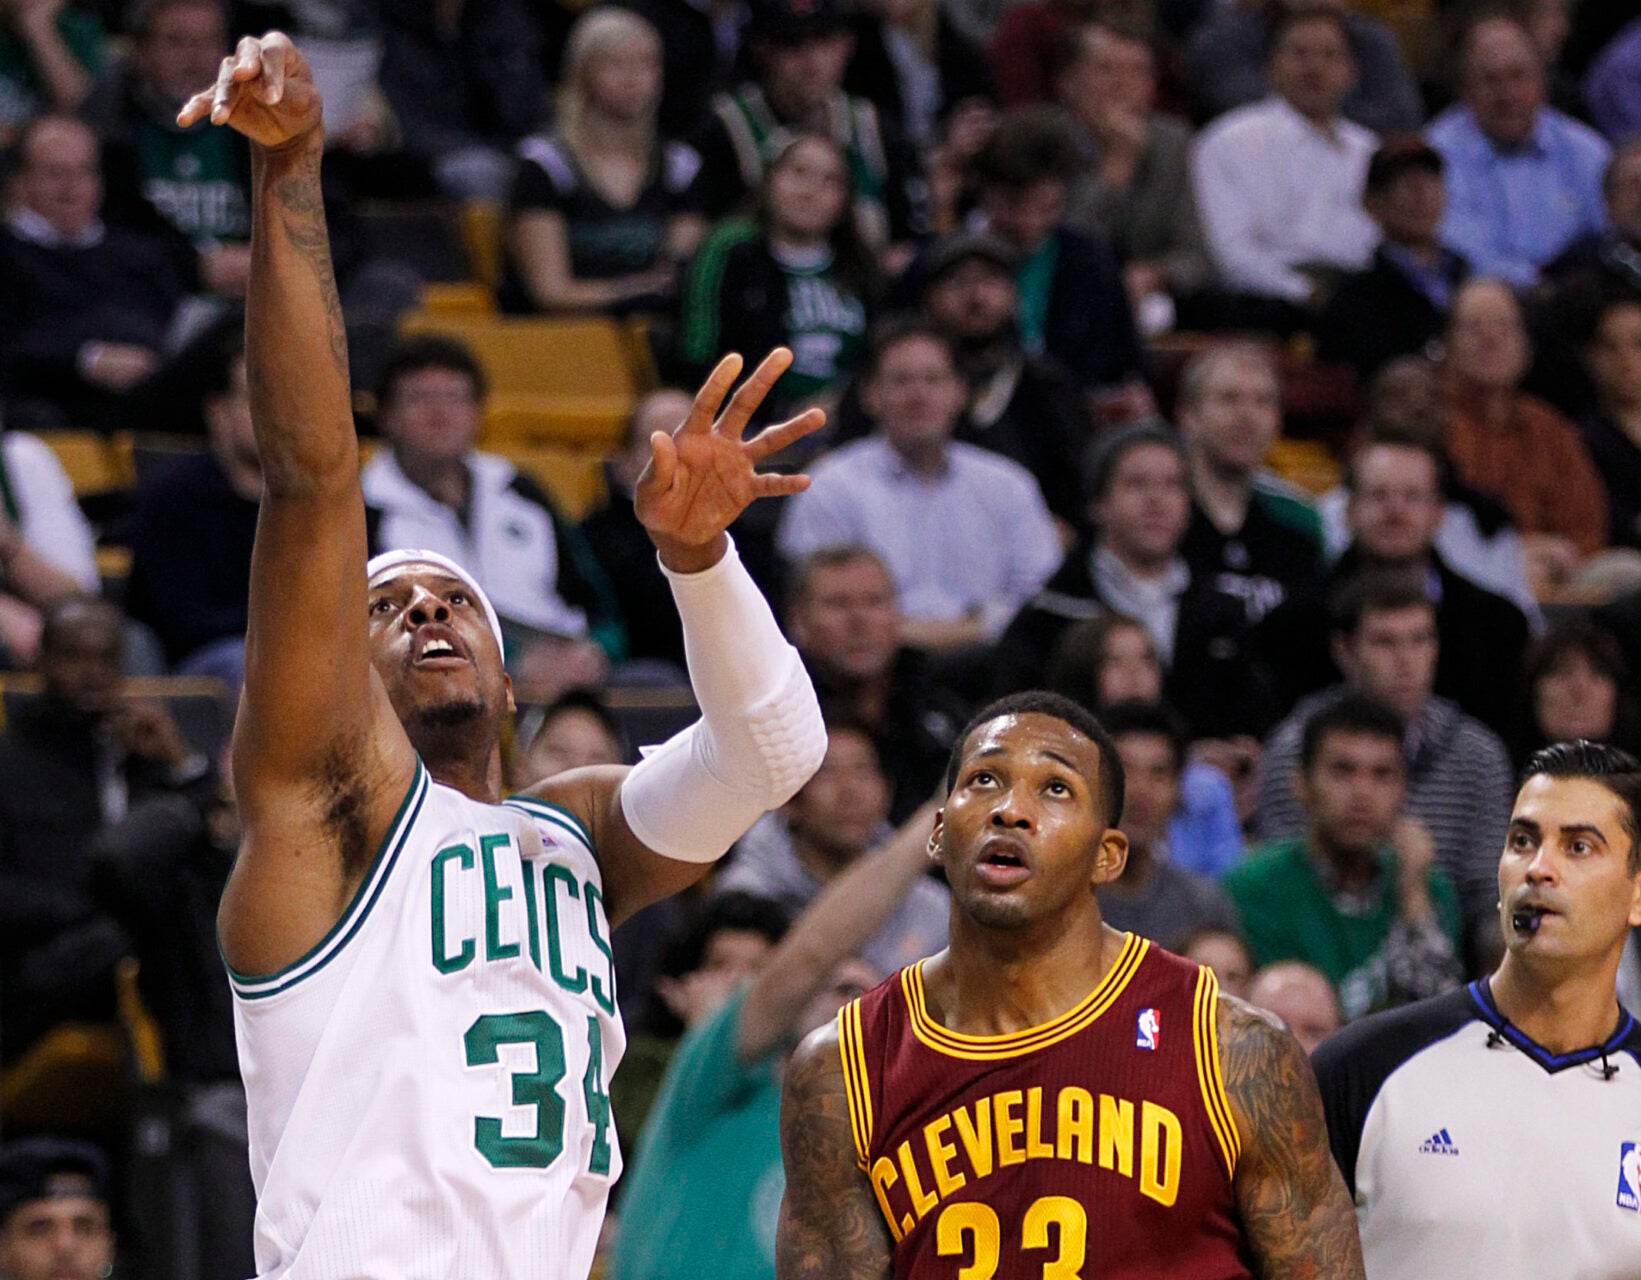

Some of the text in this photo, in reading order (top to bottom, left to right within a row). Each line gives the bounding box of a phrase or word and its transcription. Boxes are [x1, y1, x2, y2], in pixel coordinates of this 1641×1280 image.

[463, 1010, 611, 1176] 34
[870, 1086, 1183, 1243] CLEVELAND
[1619, 1191, 1638, 1210] NBA
